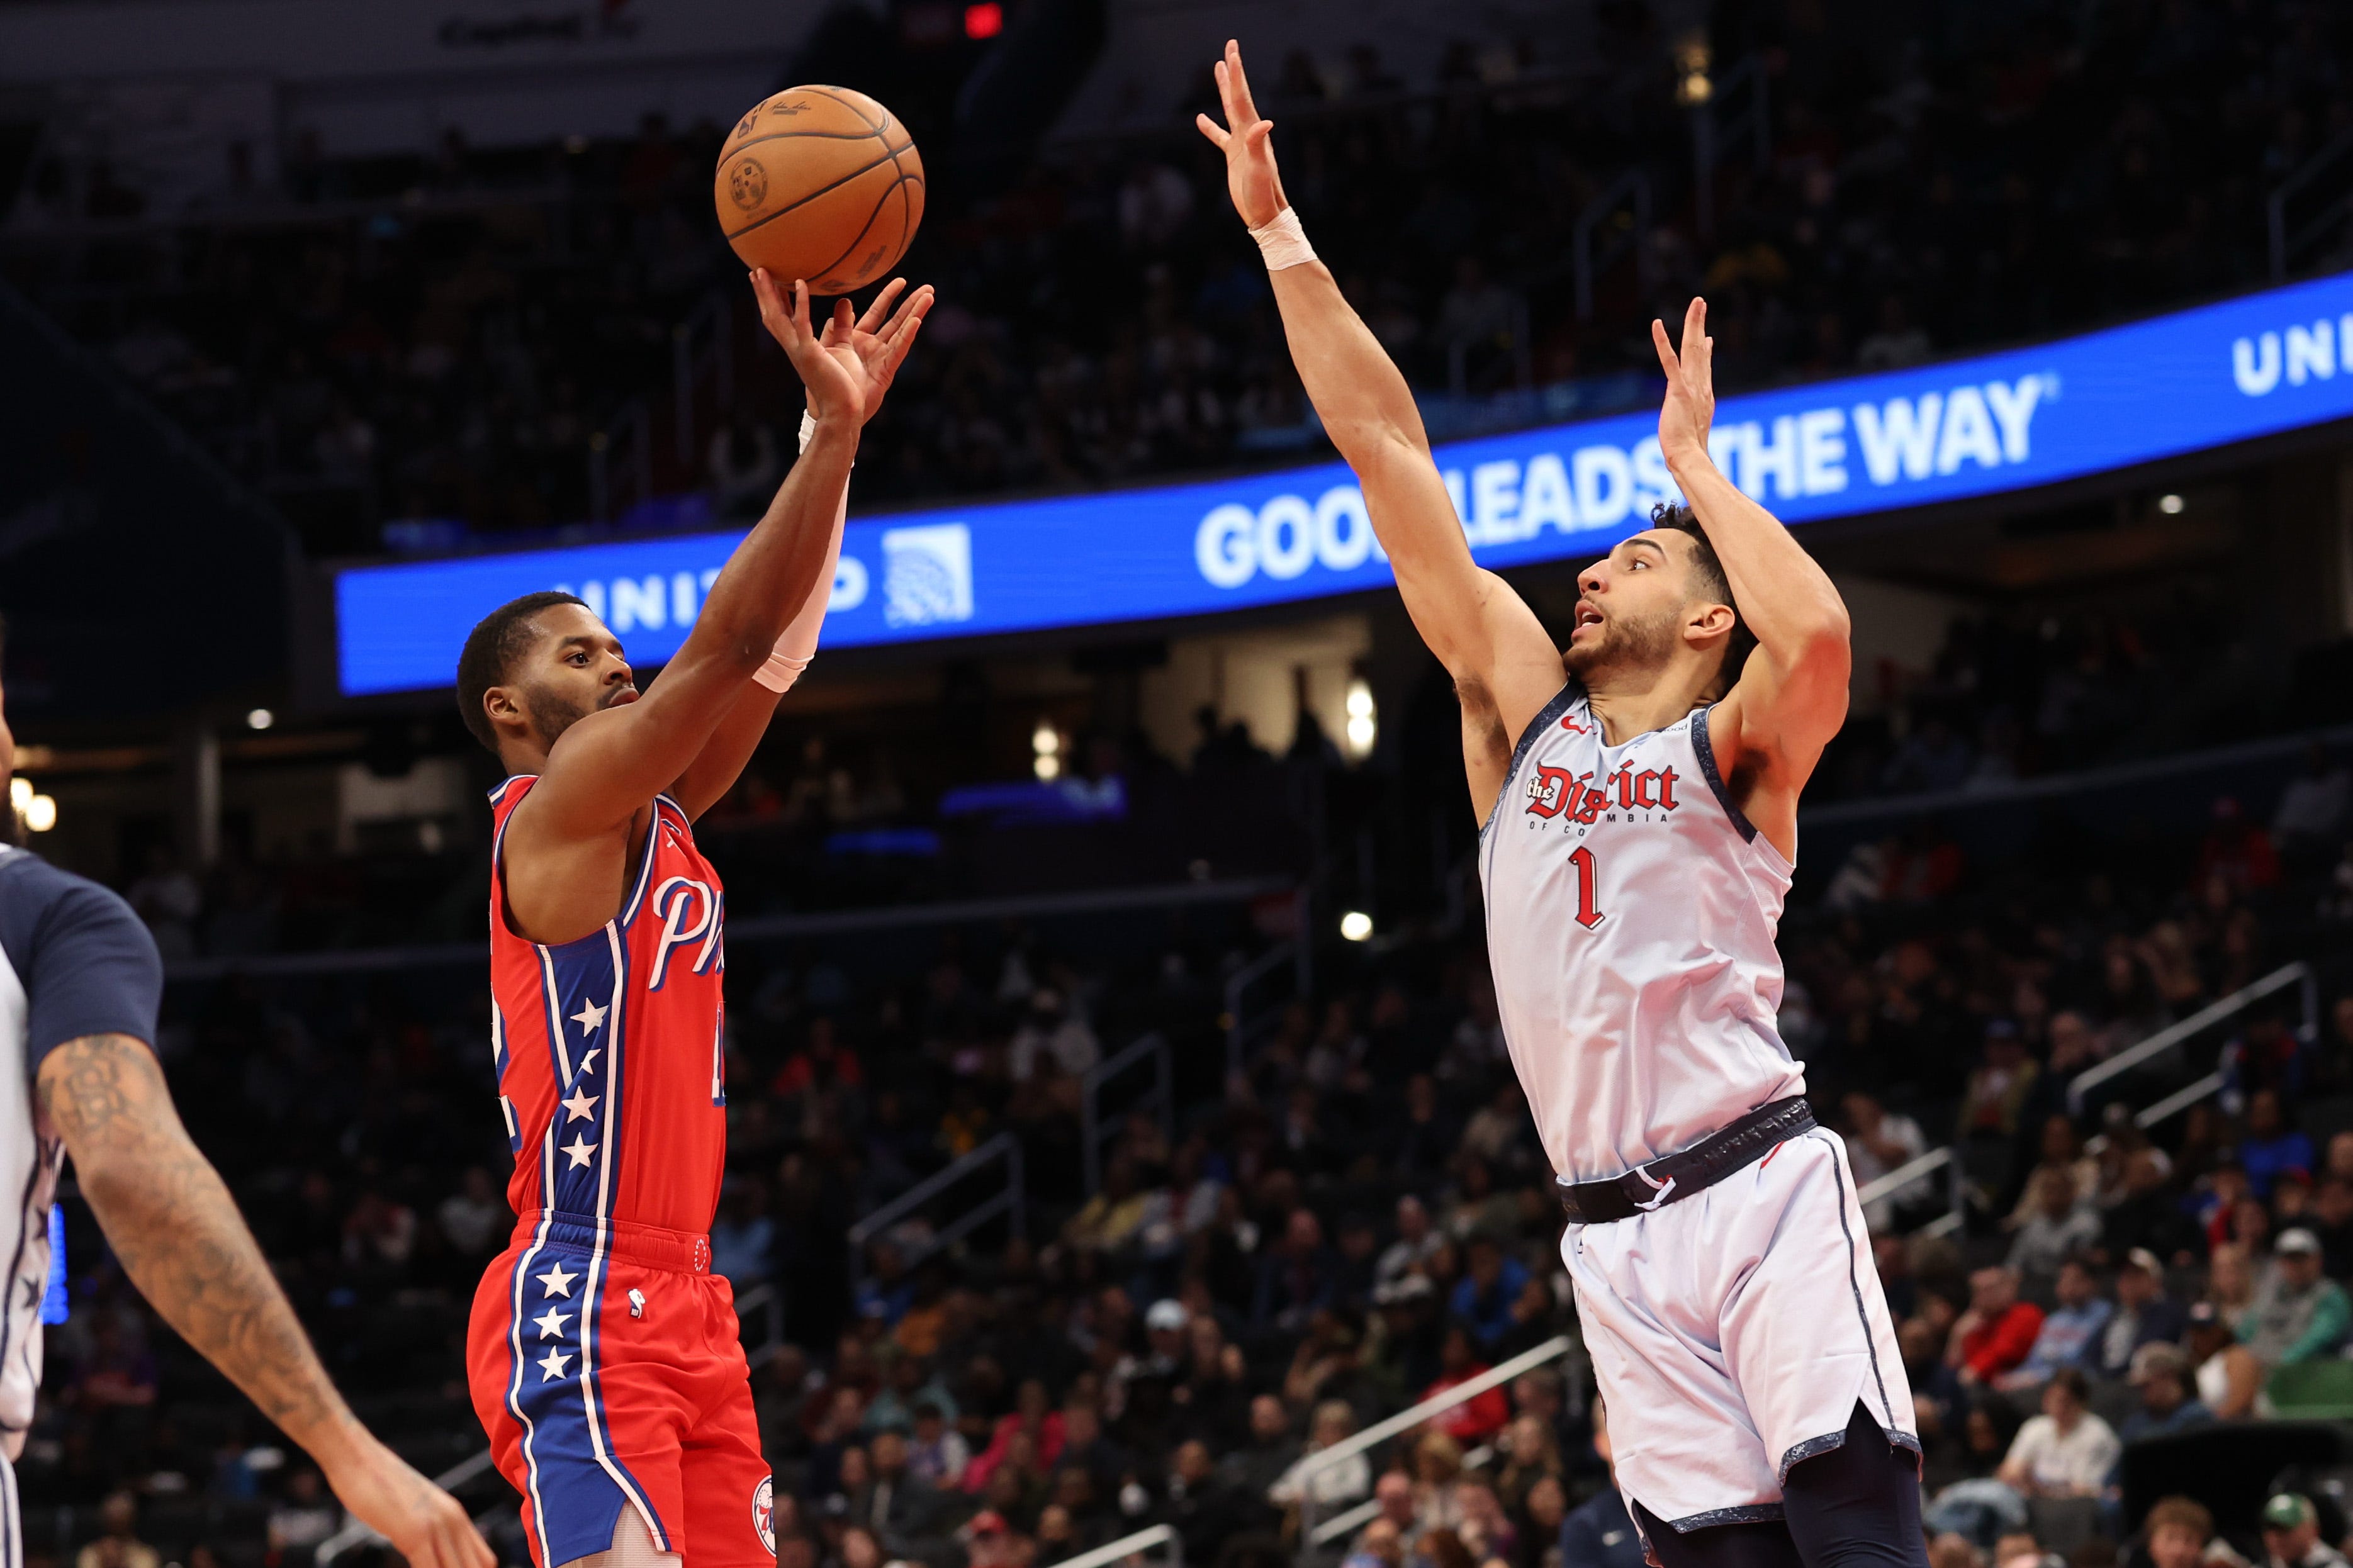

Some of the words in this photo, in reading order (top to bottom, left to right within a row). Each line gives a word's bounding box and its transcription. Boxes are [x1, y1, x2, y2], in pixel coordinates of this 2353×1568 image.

[1194, 483, 1390, 590] GOO
[1706, 406, 1848, 503] THE
[1851, 374, 2043, 486] WAY
[1526, 776, 1554, 800] the
[1529, 820, 1547, 831] OF
[1564, 814, 1668, 837] COMBIA
[1568, 845, 1605, 930] 1
